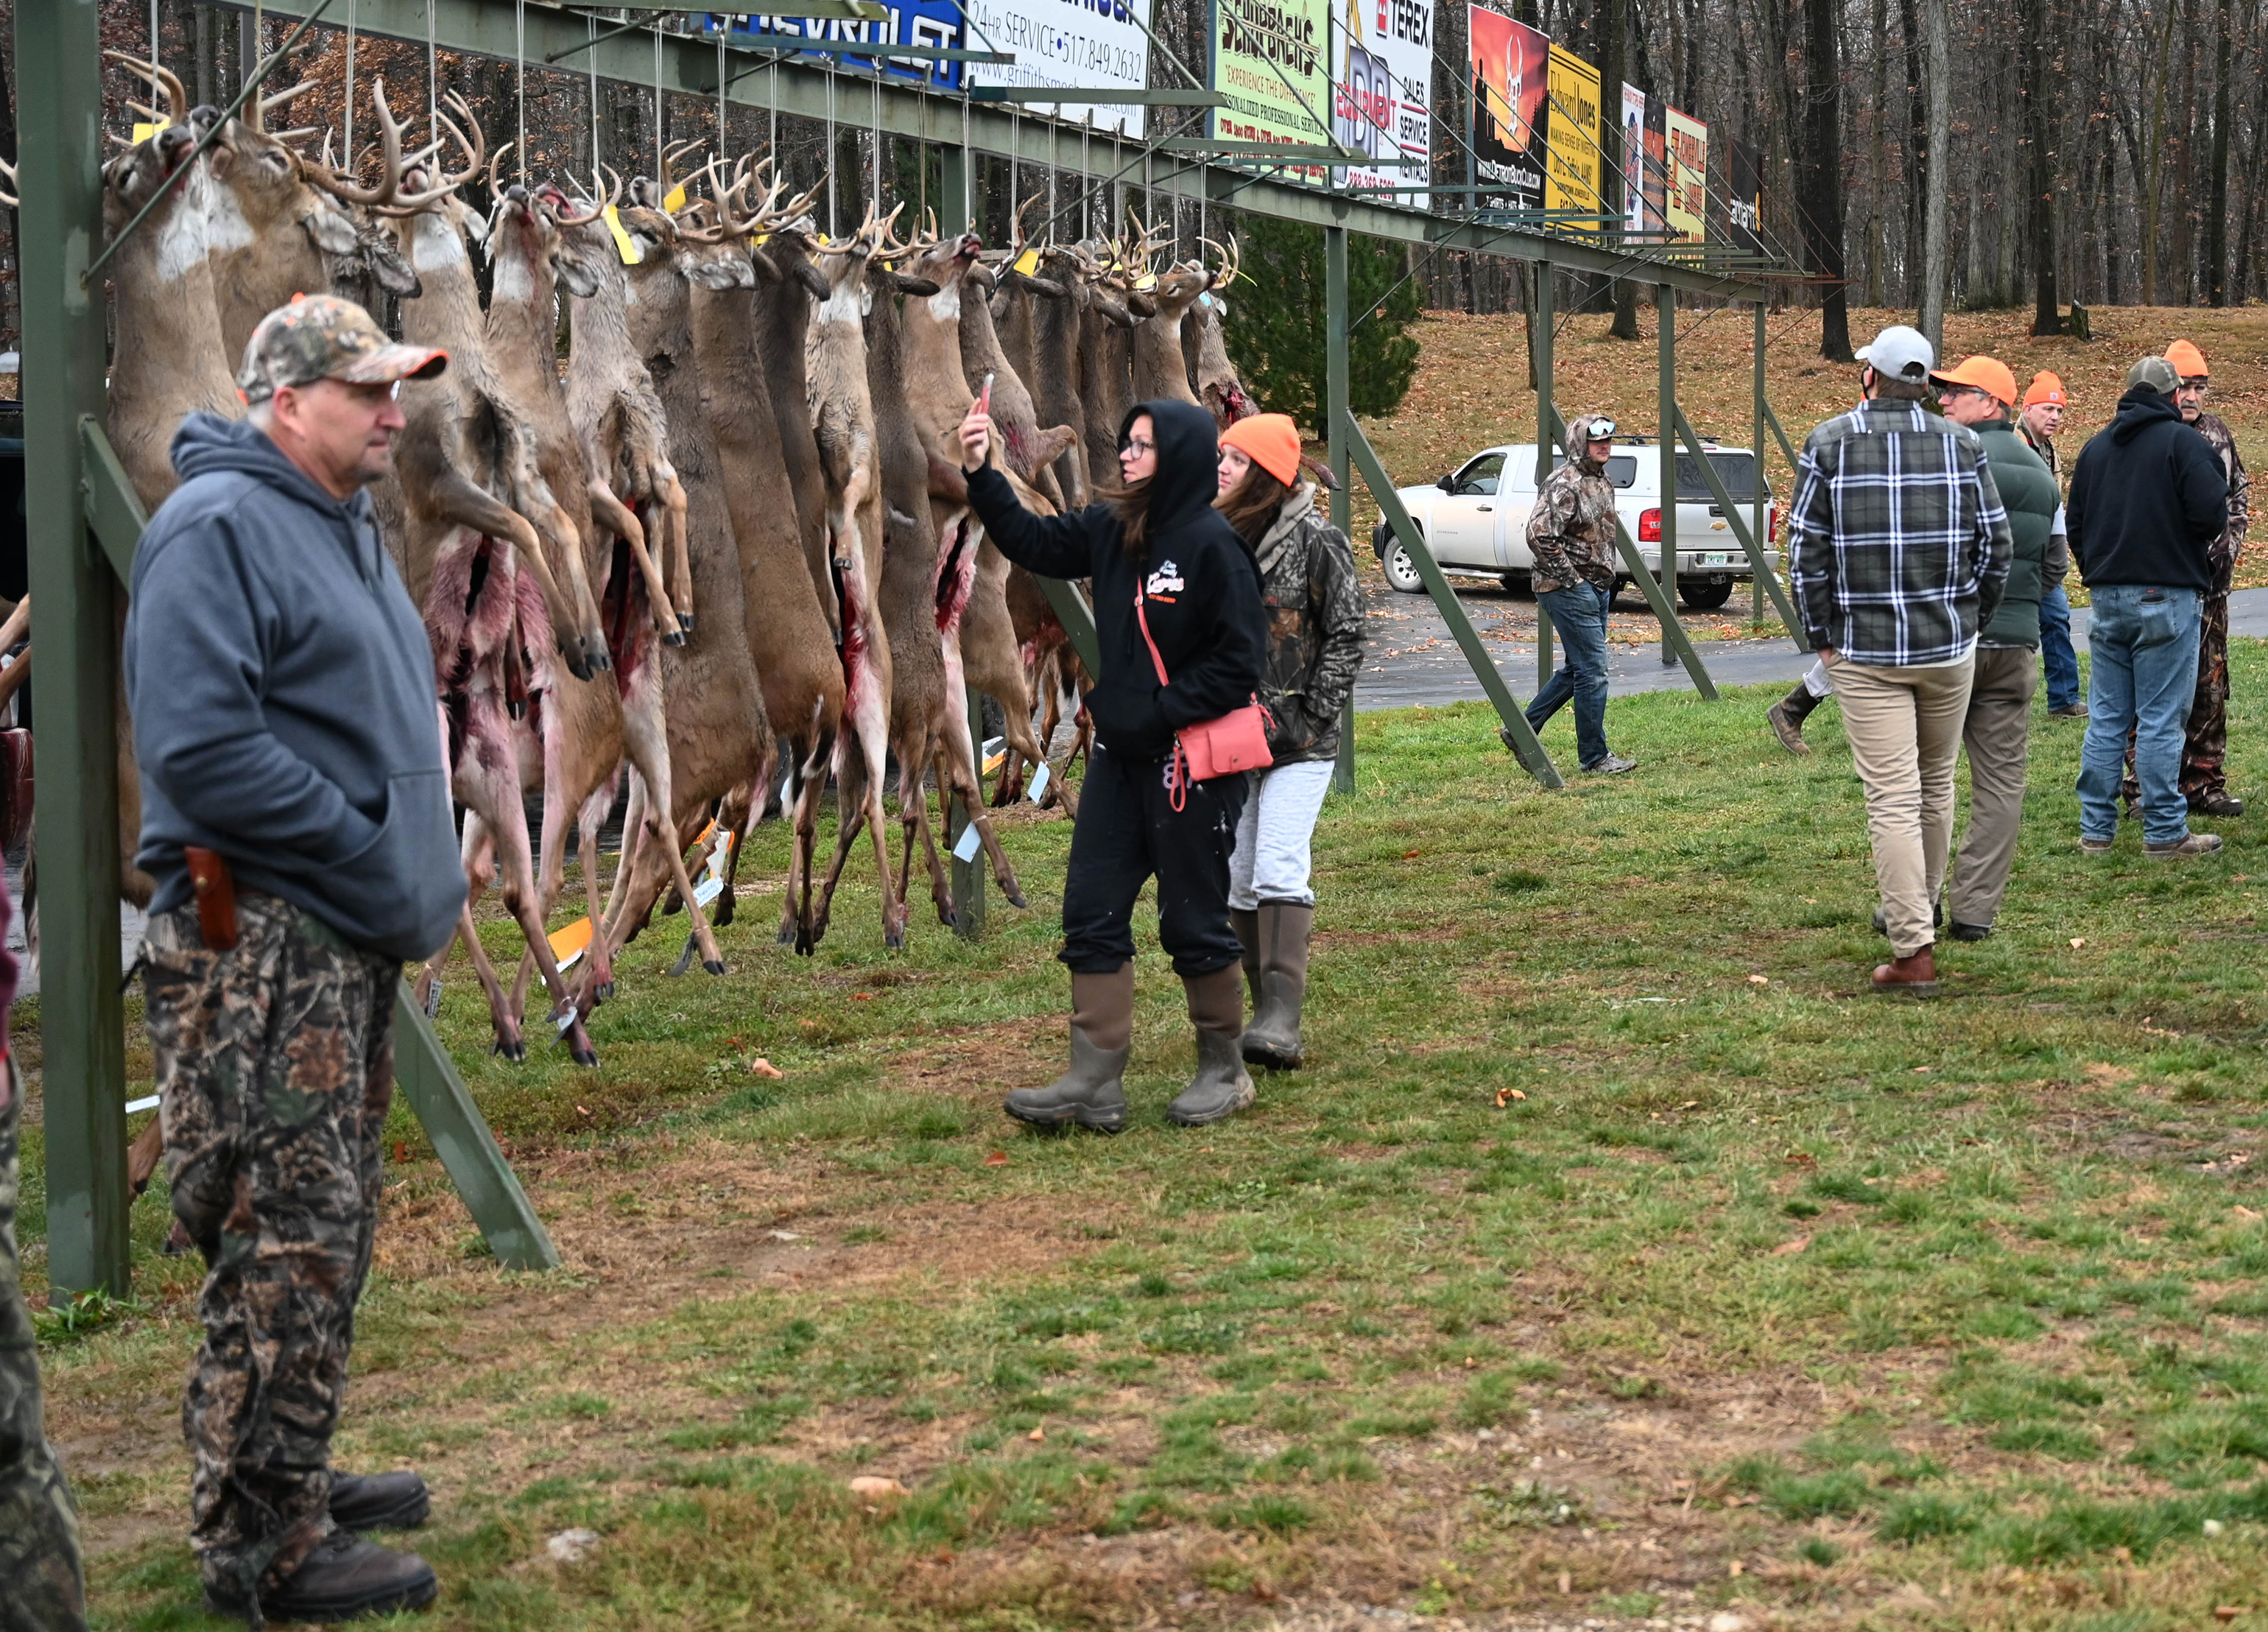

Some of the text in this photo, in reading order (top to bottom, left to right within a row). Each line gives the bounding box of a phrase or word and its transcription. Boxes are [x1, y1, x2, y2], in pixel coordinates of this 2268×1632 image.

[1391, 0, 1429, 49] TEREX
[1265, 78, 1278, 98] THE
[1404, 76, 1425, 105] SALES
[1260, 104, 1300, 129] PROFESSIONAL
[1301, 116, 1324, 136] SERVICE
[1336, 82, 1397, 133] EQUIPMENT
[1400, 115, 1427, 146] SERVICE
[1400, 153, 1428, 184] RENTALS
[1730, 195, 1756, 231] arhartt
